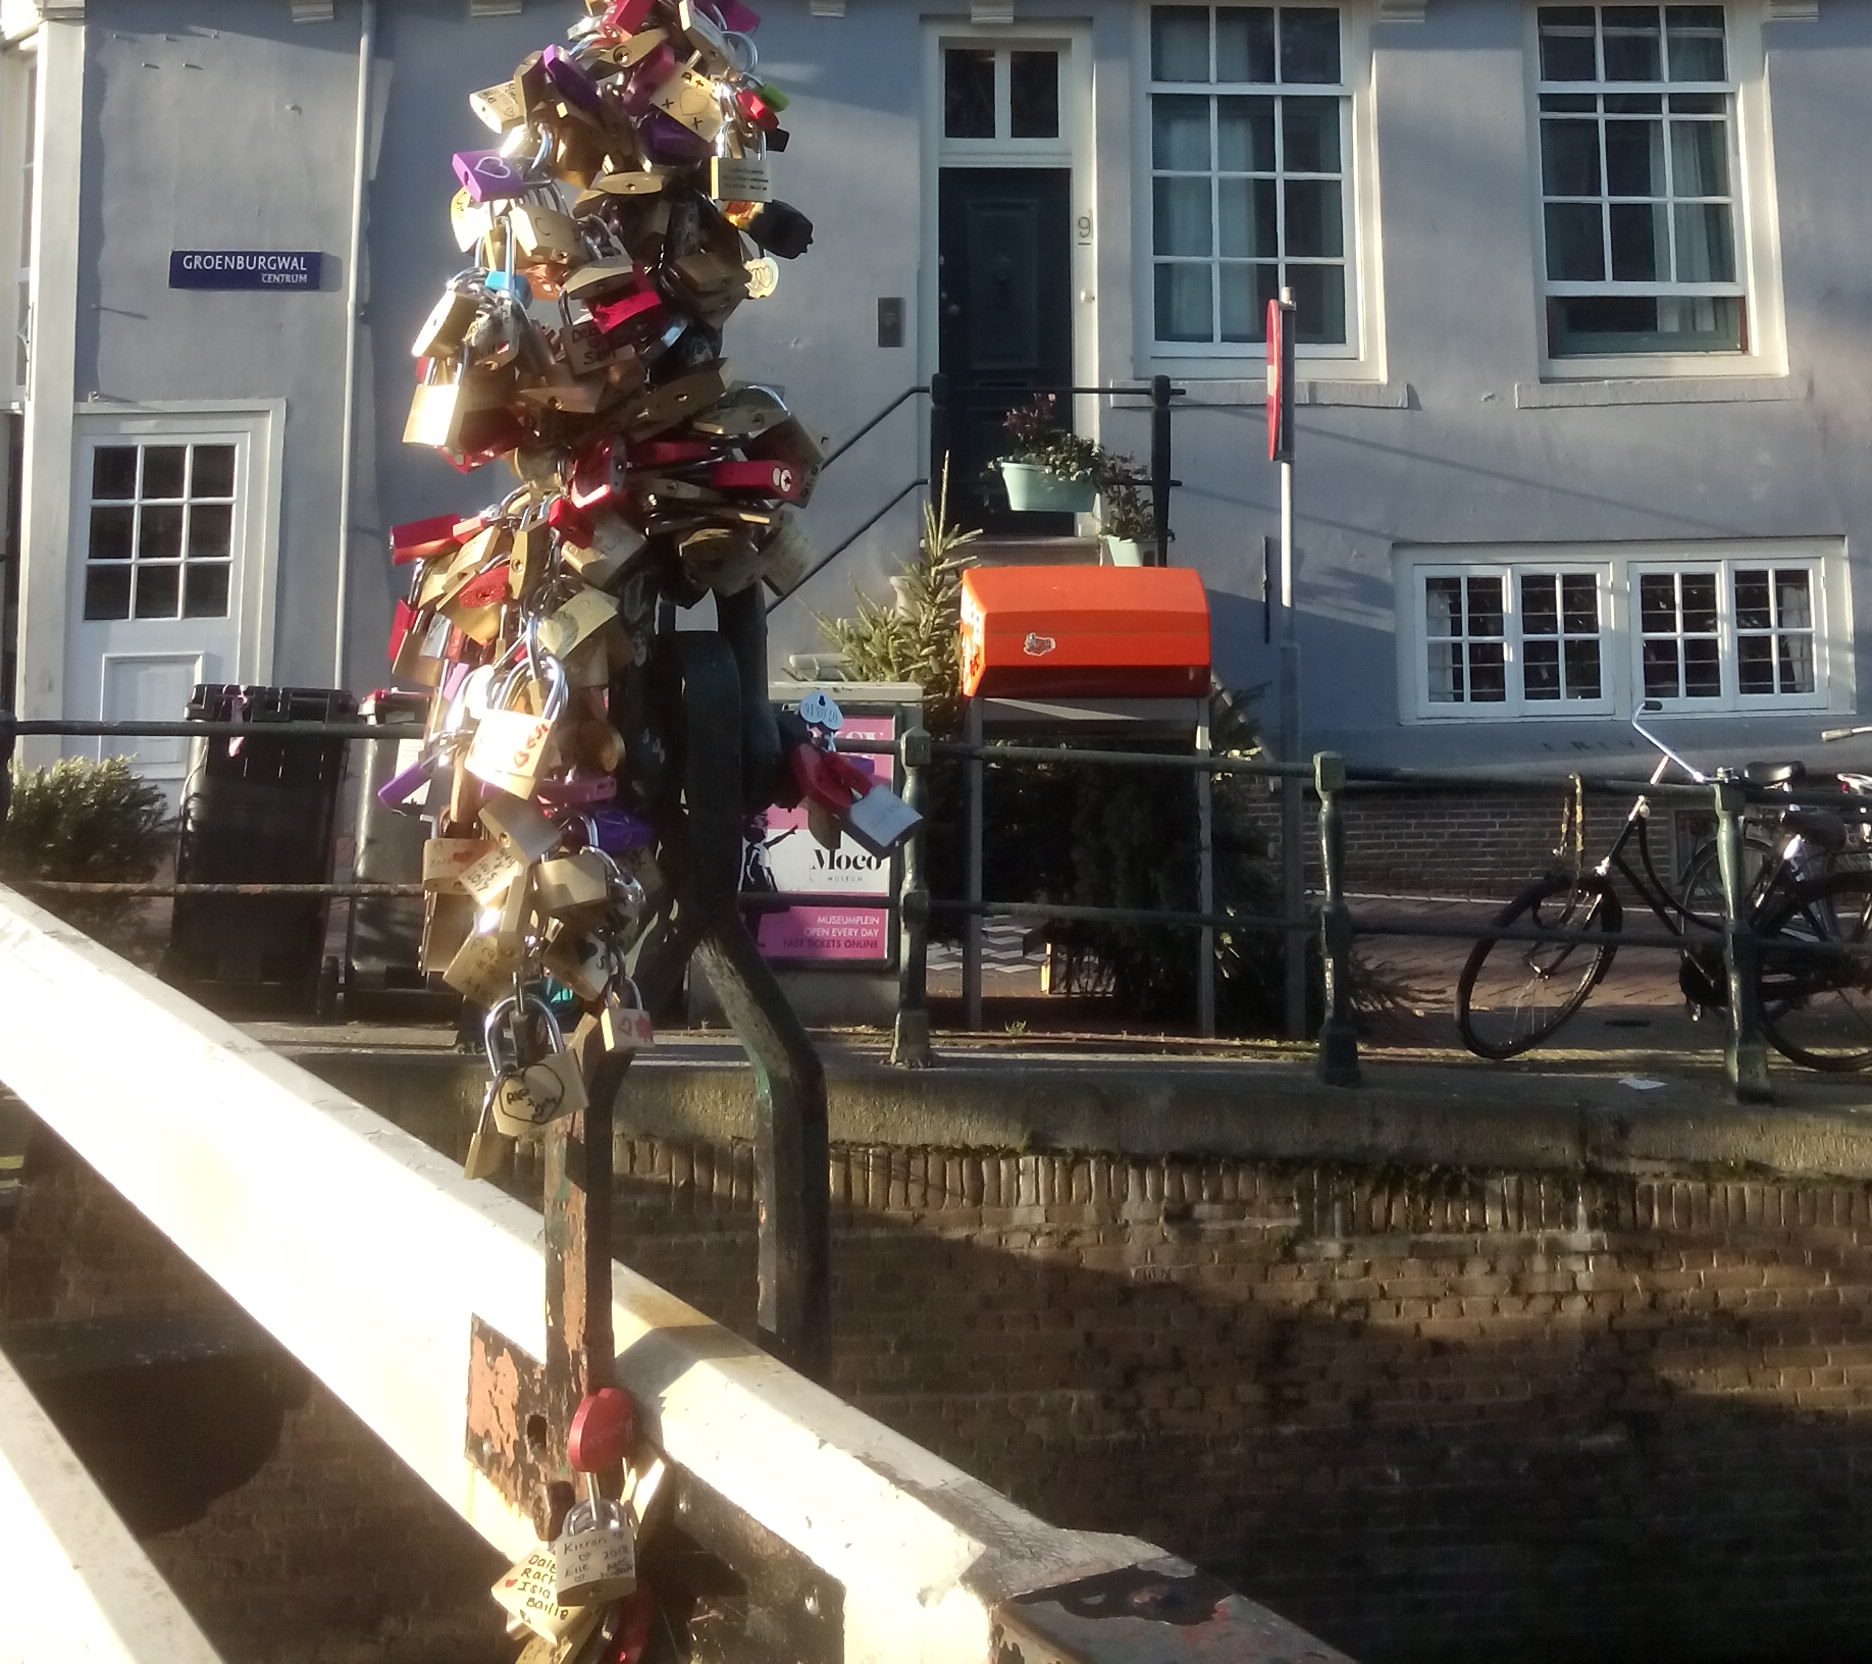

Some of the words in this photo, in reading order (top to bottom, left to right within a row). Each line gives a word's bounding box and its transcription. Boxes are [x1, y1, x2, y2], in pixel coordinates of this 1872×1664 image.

[1078, 216, 1091, 238] 9
[182, 255, 307, 271] GROENBURGWAL
[261, 273, 307, 283] CENTRUM
[811, 849, 882, 870] Moco
[817, 915, 880, 925] MUSEUMPLEIN
[803, 927, 830, 937] OPEN
[831, 927, 859, 937] EVERY
[861, 927, 880, 937] DAY
[783, 939, 804, 948] FAST
[807, 939, 841, 948] TICKETS
[844, 940, 878, 948] ONLINE
